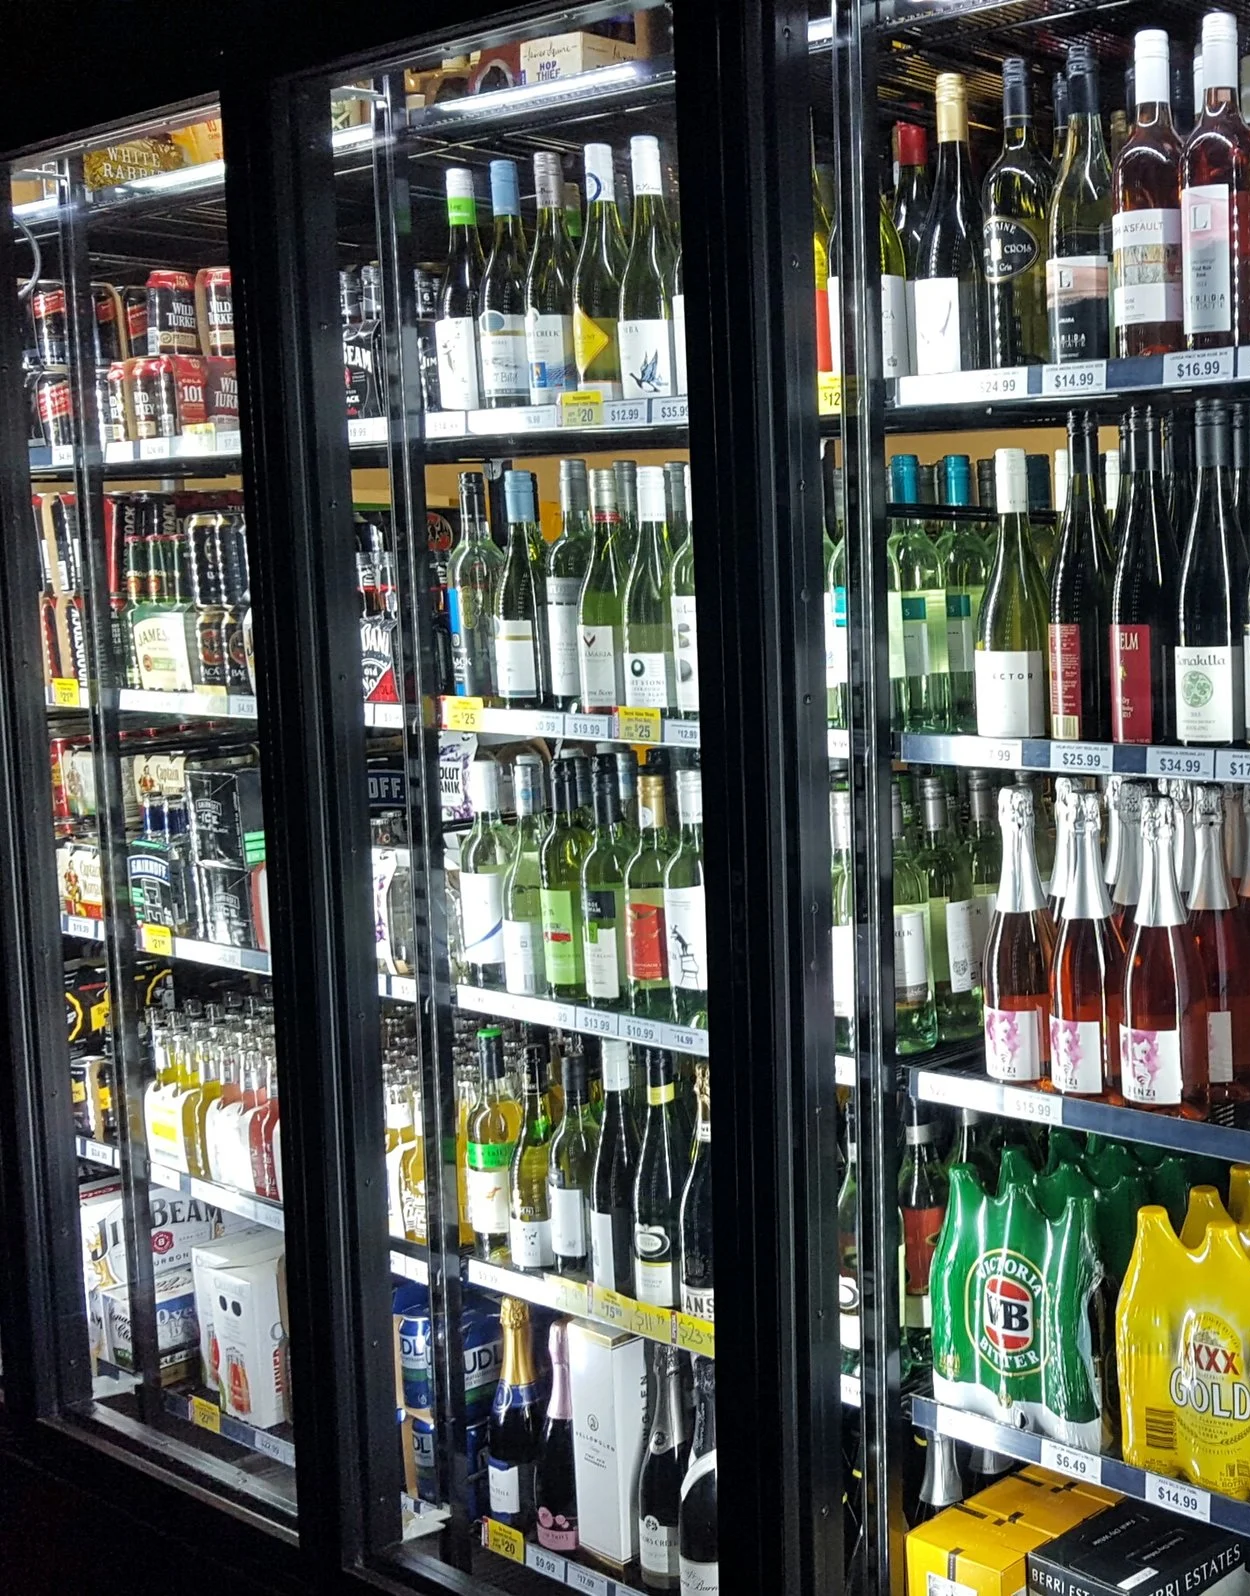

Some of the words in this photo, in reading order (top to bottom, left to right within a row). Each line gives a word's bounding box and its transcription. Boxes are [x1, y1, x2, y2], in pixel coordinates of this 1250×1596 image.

[536, 69, 561, 82] THIEF
[539, 61, 557, 72] HOP
[107, 147, 160, 168] WHITE
[172, 303, 194, 316] WILD
[1177, 361, 1220, 379] $16.99
[1055, 373, 1094, 389] $14.99
[183, 385, 204, 402] 101
[611, 409, 639, 421] $12.99
[1062, 753, 1101, 767] $25.99
[1160, 759, 1201, 773] $34.99
[627, 1025, 653, 1039] $10.99
[150, 1200, 224, 1228] BEAM
[975, 1258, 1043, 1296] VICTORIA
[986, 1292, 1030, 1332] VB
[979, 1335, 1041, 1370] BITTER
[1184, 1341, 1240, 1376] XXXX
[1056, 1454, 1086, 1474] $6.49
[1158, 1487, 1198, 1512] $14.99
[1185, 1544, 1241, 1593] ESTATES
[1031, 1567, 1065, 1593] BERRI
